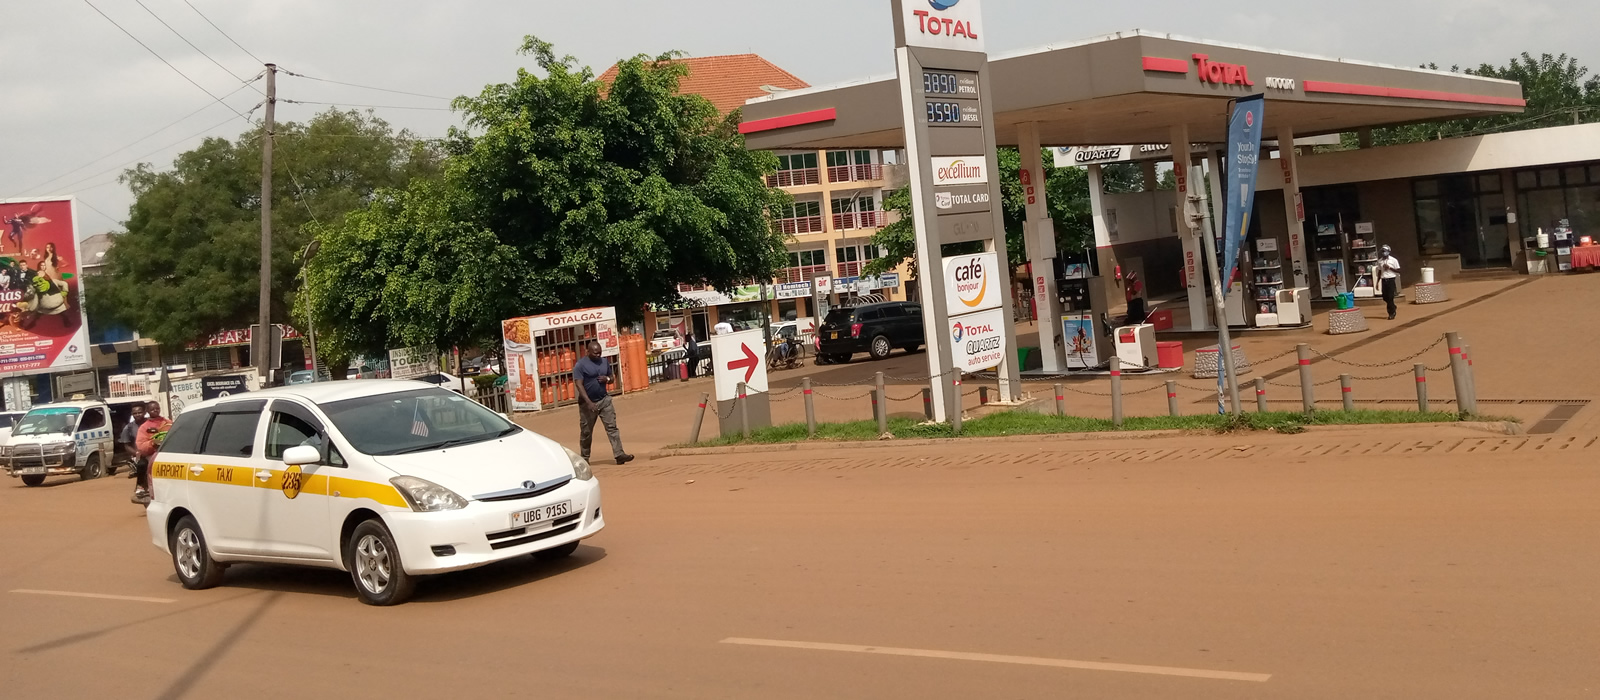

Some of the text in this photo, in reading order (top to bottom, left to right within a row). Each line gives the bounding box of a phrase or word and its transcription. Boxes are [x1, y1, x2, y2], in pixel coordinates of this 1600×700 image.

[913, 9, 978, 39] TOTAL
[1192, 53, 1254, 86] TOTAL
[924, 73, 956, 93] 3890
[926, 103, 959, 122] 3590
[1075, 148, 1120, 162] QUARTZ
[938, 163, 981, 179] excellium
[952, 193, 989, 205] TOTAL CARD
[955, 258, 982, 282] café
[818, 279, 827, 287] air
[957, 282, 979, 294] bonjour
[546, 312, 603, 326] TOTALGAZ
[965, 324, 993, 336] TOTAL
[966, 336, 1000, 355] QUARTZ
[968, 351, 1001, 366] auto service
[155, 464, 185, 478] AIRPORT
[216, 467, 234, 482] TAXI
[283, 472, 301, 490] 235
[523, 502, 568, 524] UBG 915S
